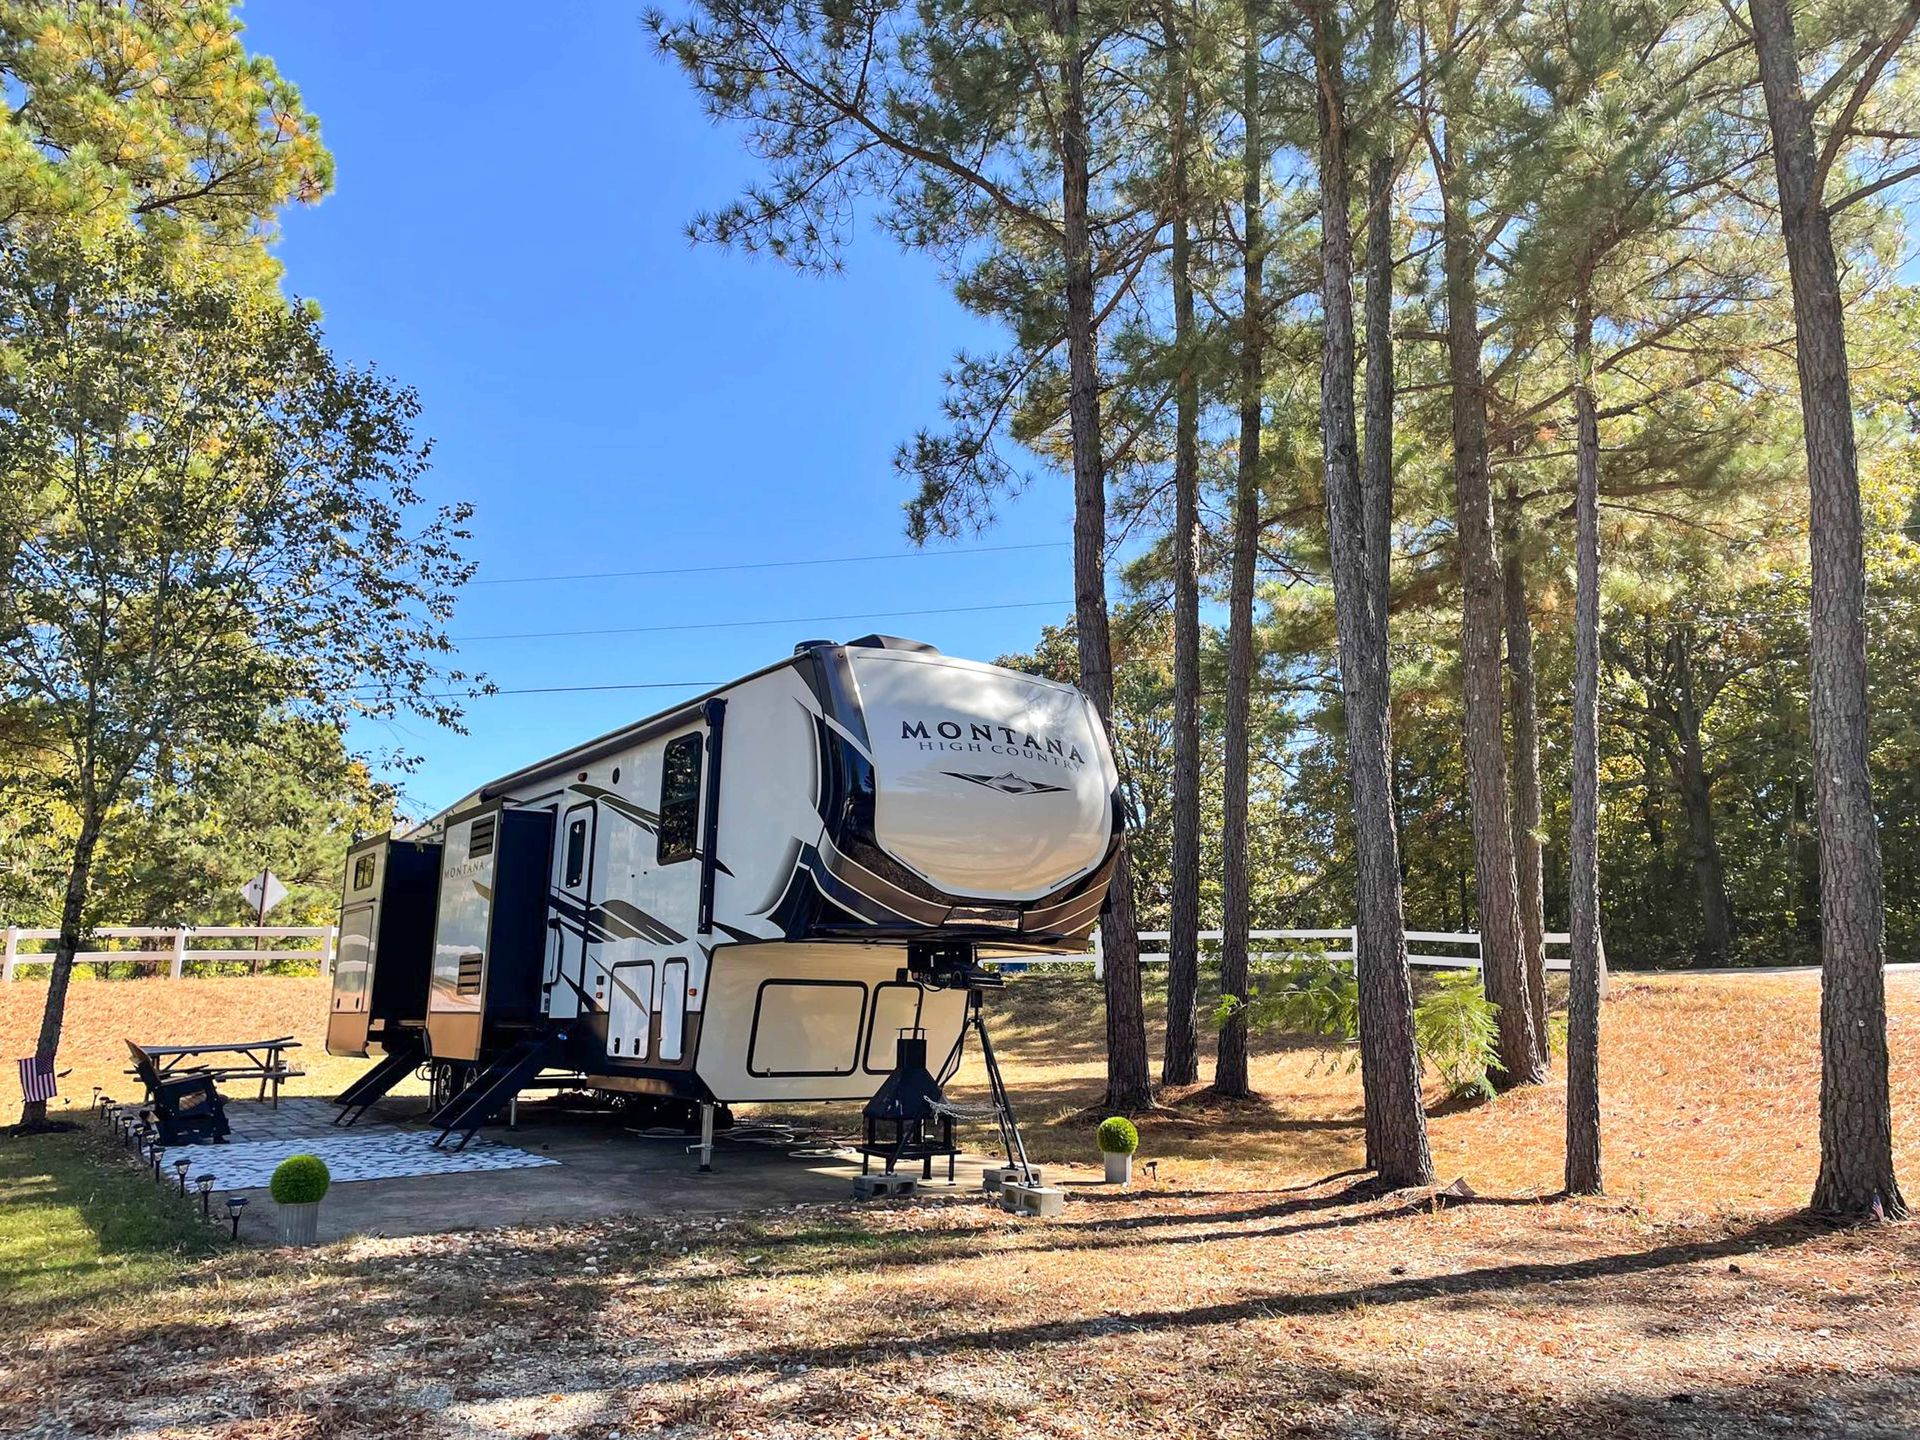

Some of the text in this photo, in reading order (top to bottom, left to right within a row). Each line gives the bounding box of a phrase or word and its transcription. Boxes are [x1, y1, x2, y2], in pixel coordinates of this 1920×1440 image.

[901, 720, 1085, 764] MONTANA
[919, 741, 1082, 772] HIGH COUNTRY
[444, 860, 485, 880] MONTANA
